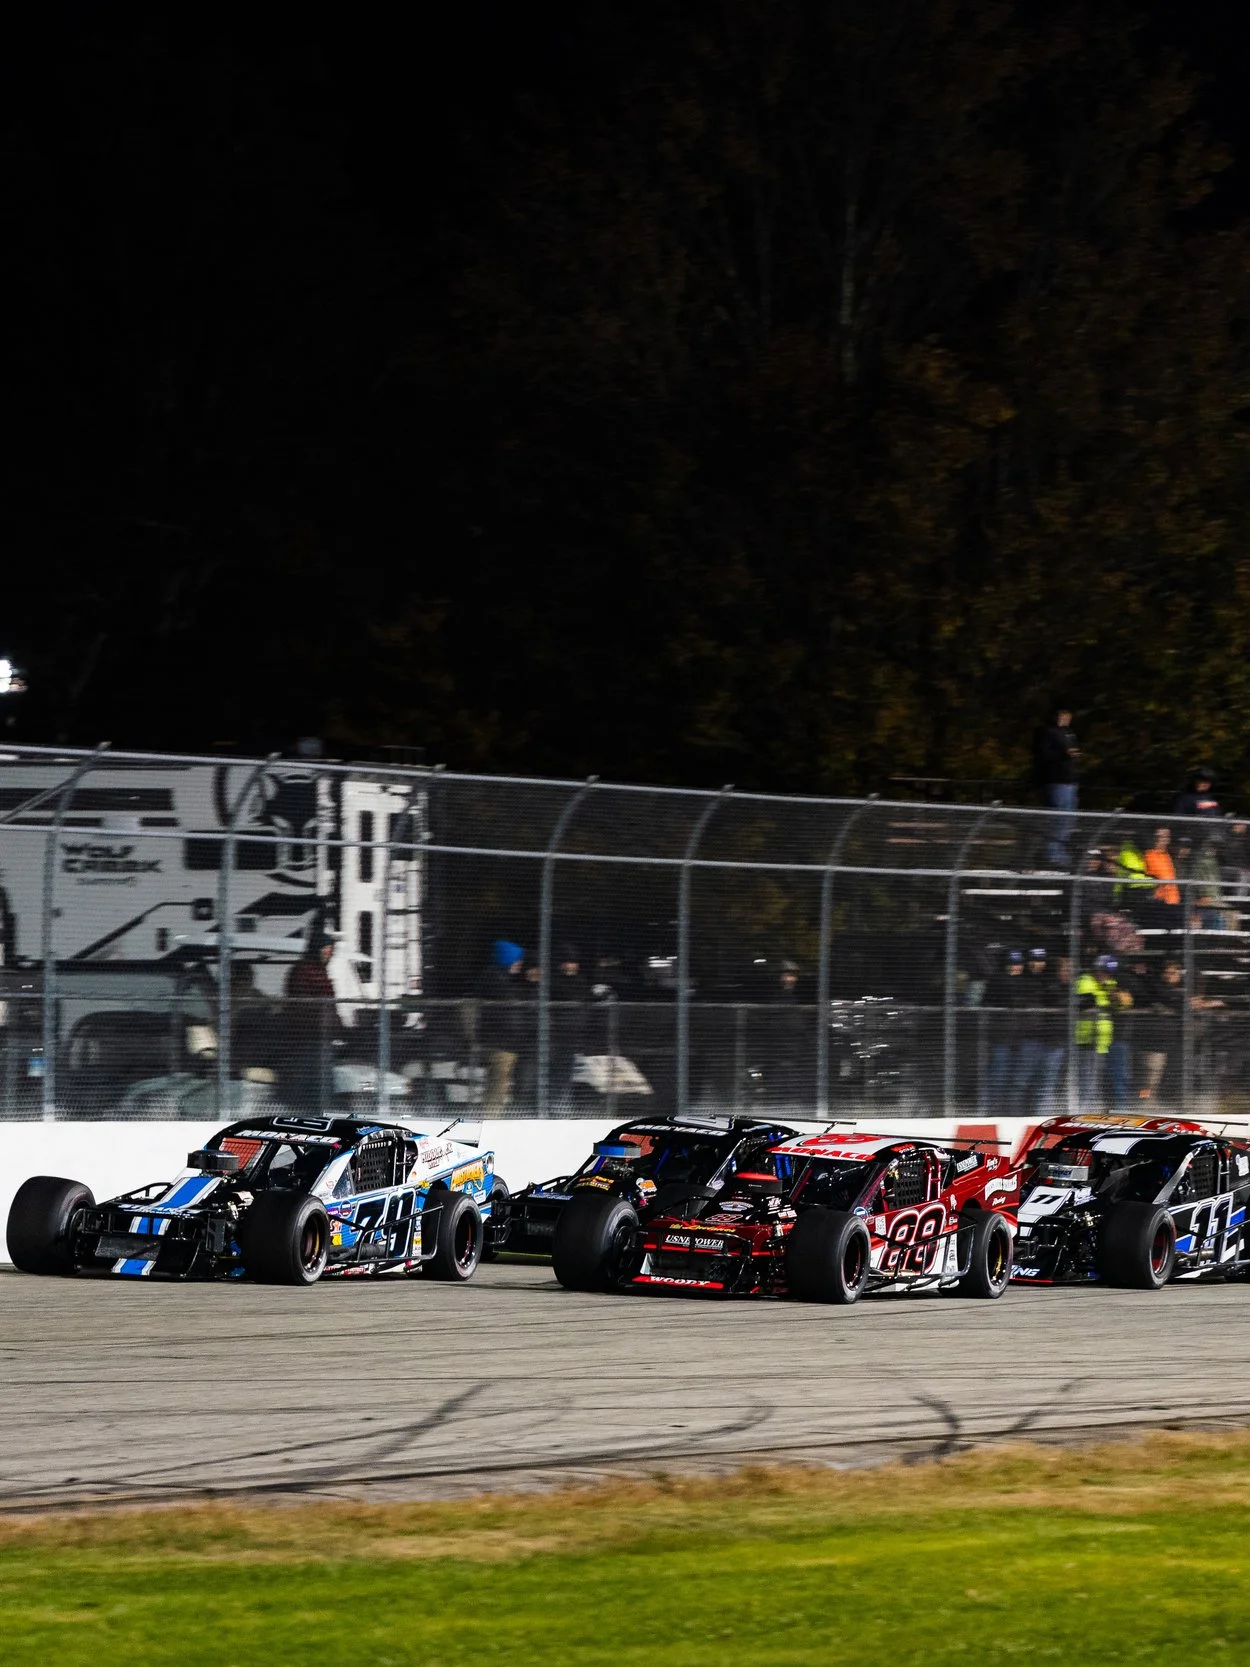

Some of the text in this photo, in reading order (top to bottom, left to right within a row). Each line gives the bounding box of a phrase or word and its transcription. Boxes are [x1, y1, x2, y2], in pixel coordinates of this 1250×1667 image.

[765, 1146, 876, 1161] MONACO
[1031, 1194, 1063, 1204] 11
[877, 1203, 946, 1275] 88
[649, 1276, 711, 1286] WOODY
